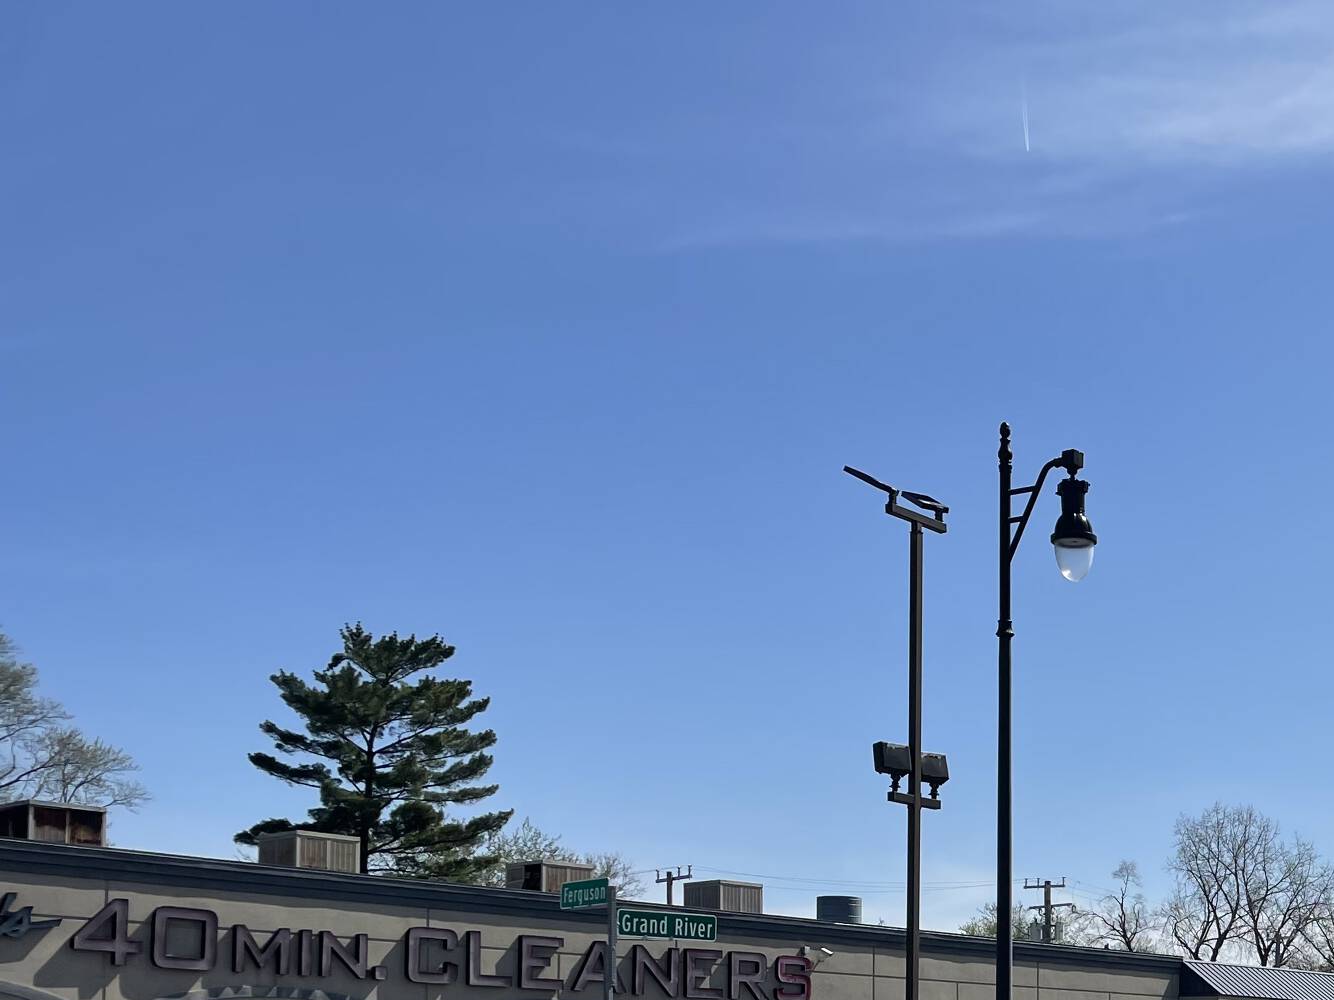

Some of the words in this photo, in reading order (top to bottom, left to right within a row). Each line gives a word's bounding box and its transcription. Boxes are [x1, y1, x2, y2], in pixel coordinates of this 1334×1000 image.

[563, 886, 606, 905] Ferguson
[71, 898, 218, 971] 40
[622, 914, 668, 935] Grand
[674, 917, 713, 938] River
